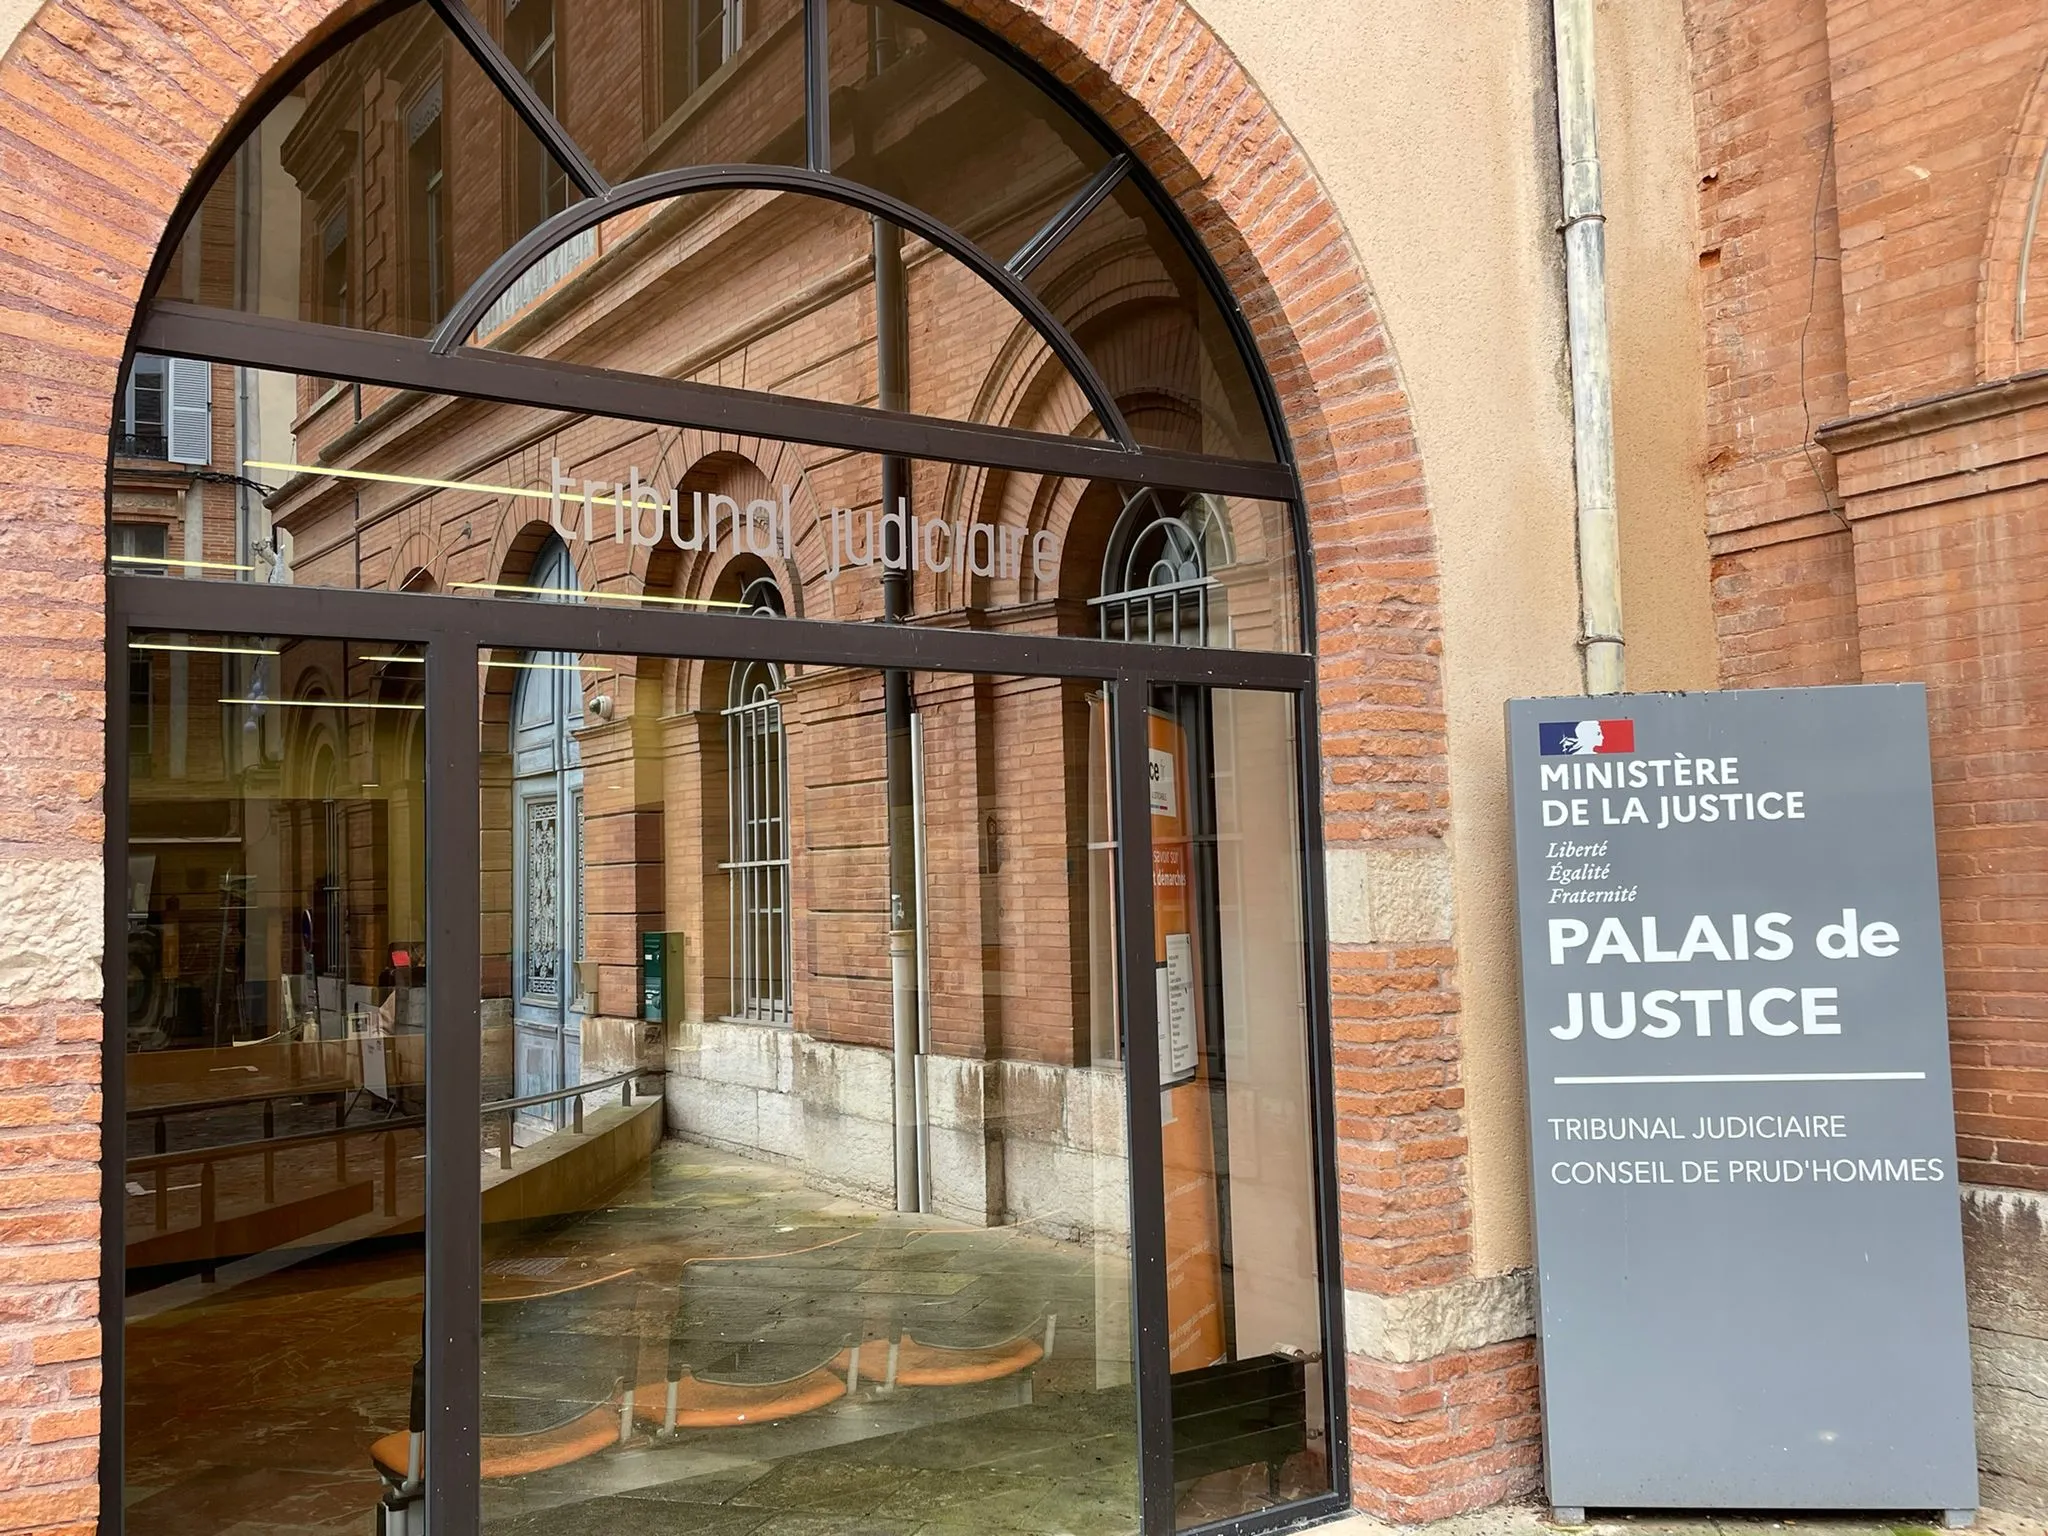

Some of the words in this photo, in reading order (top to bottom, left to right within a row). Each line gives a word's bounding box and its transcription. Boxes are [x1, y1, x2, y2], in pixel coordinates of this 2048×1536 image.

[551, 457, 791, 559] tribunal
[825, 497, 1058, 582] judiciaire
[1540, 753, 1740, 791] MINISTÈRE
[1542, 798, 1590, 828] DE
[1601, 796, 1650, 826] LA
[1656, 791, 1806, 829] JUSTICE
[1545, 839, 1609, 859] Liberté
[1546, 861, 1611, 885] Égalité
[1547, 885, 1638, 904] Fraternité
[1548, 911, 1794, 965] PALAIS
[1815, 908, 1900, 960] de
[1548, 987, 1842, 1041] JUSTICE
[1547, 1116, 1686, 1141] TRIBUNAL
[1691, 1115, 1847, 1140] JUDICIAIRE
[1551, 1160, 1675, 1185] CONSEIL
[1681, 1160, 1721, 1184] DE
[1728, 1157, 1945, 1184] PRUD'HOMMES
